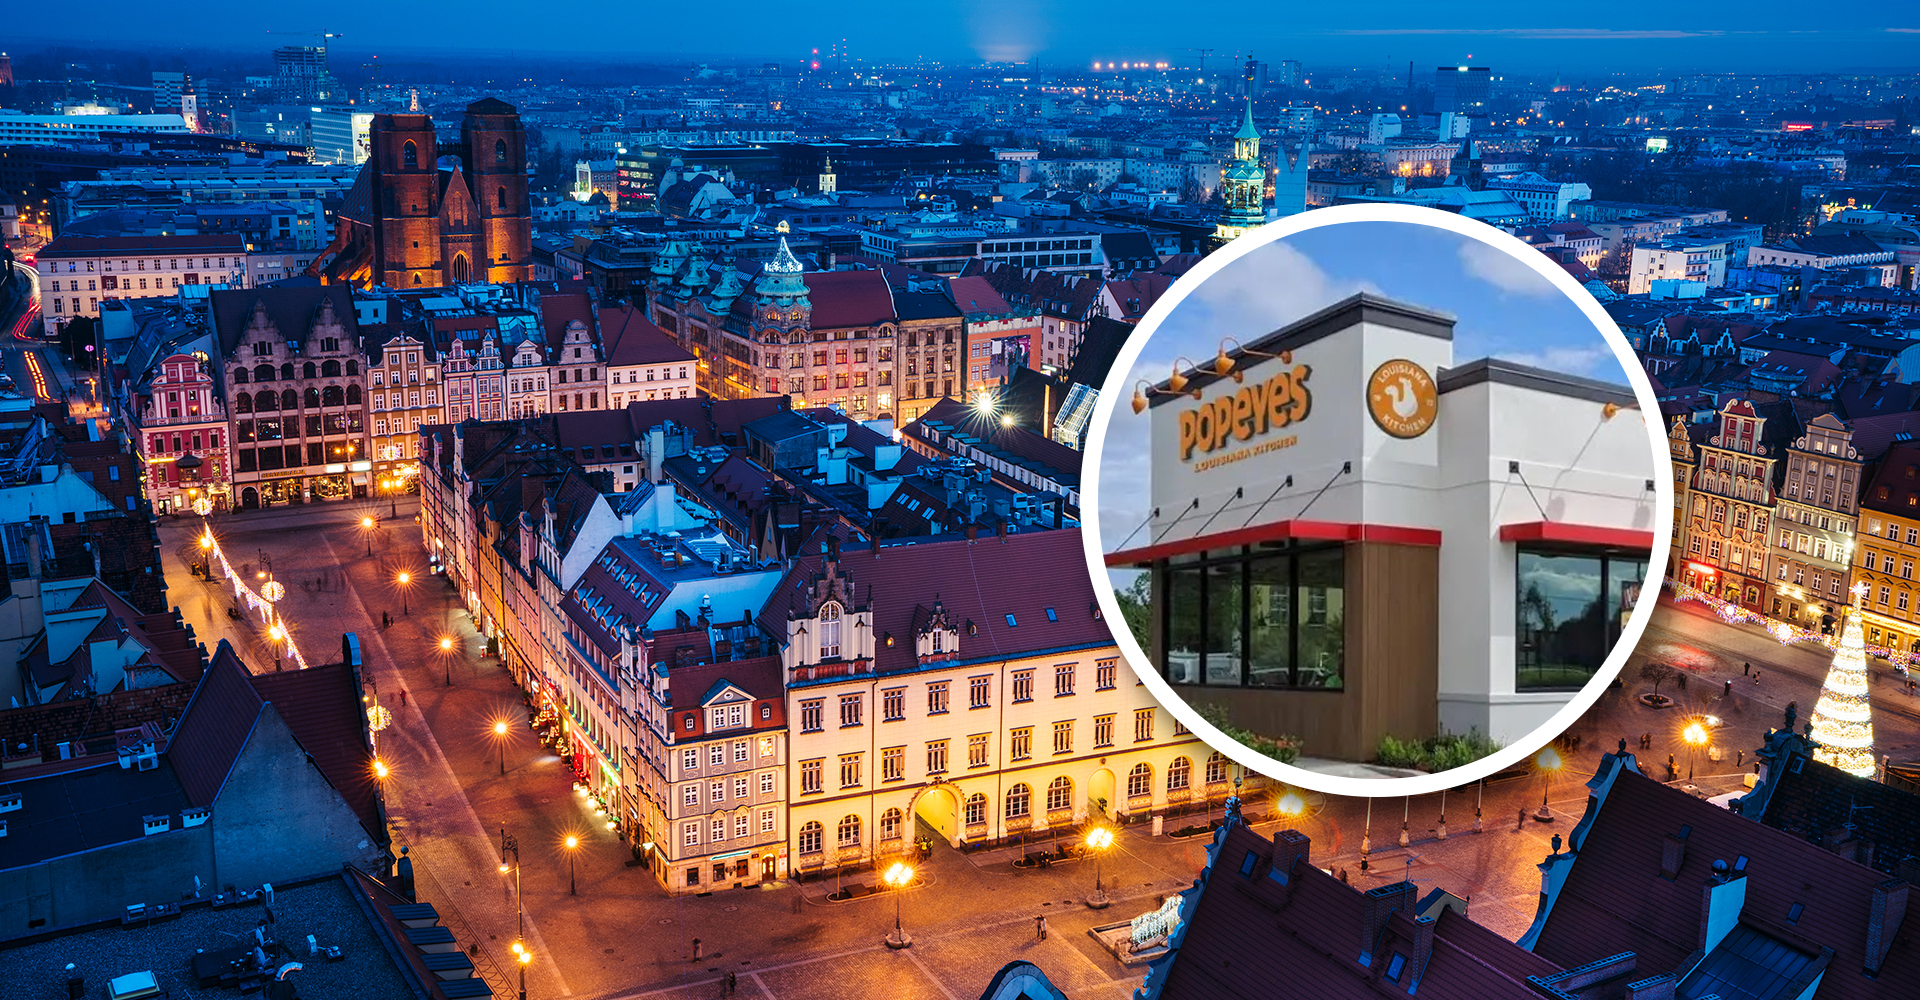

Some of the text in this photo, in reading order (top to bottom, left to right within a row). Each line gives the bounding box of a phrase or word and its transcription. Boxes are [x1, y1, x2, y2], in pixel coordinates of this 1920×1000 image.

[1377, 364, 1428, 387] LOUISIANA
[1382, 413, 1427, 432] KITCHEN
[1194, 436, 1298, 473] LOUISIANA KITCHEN
